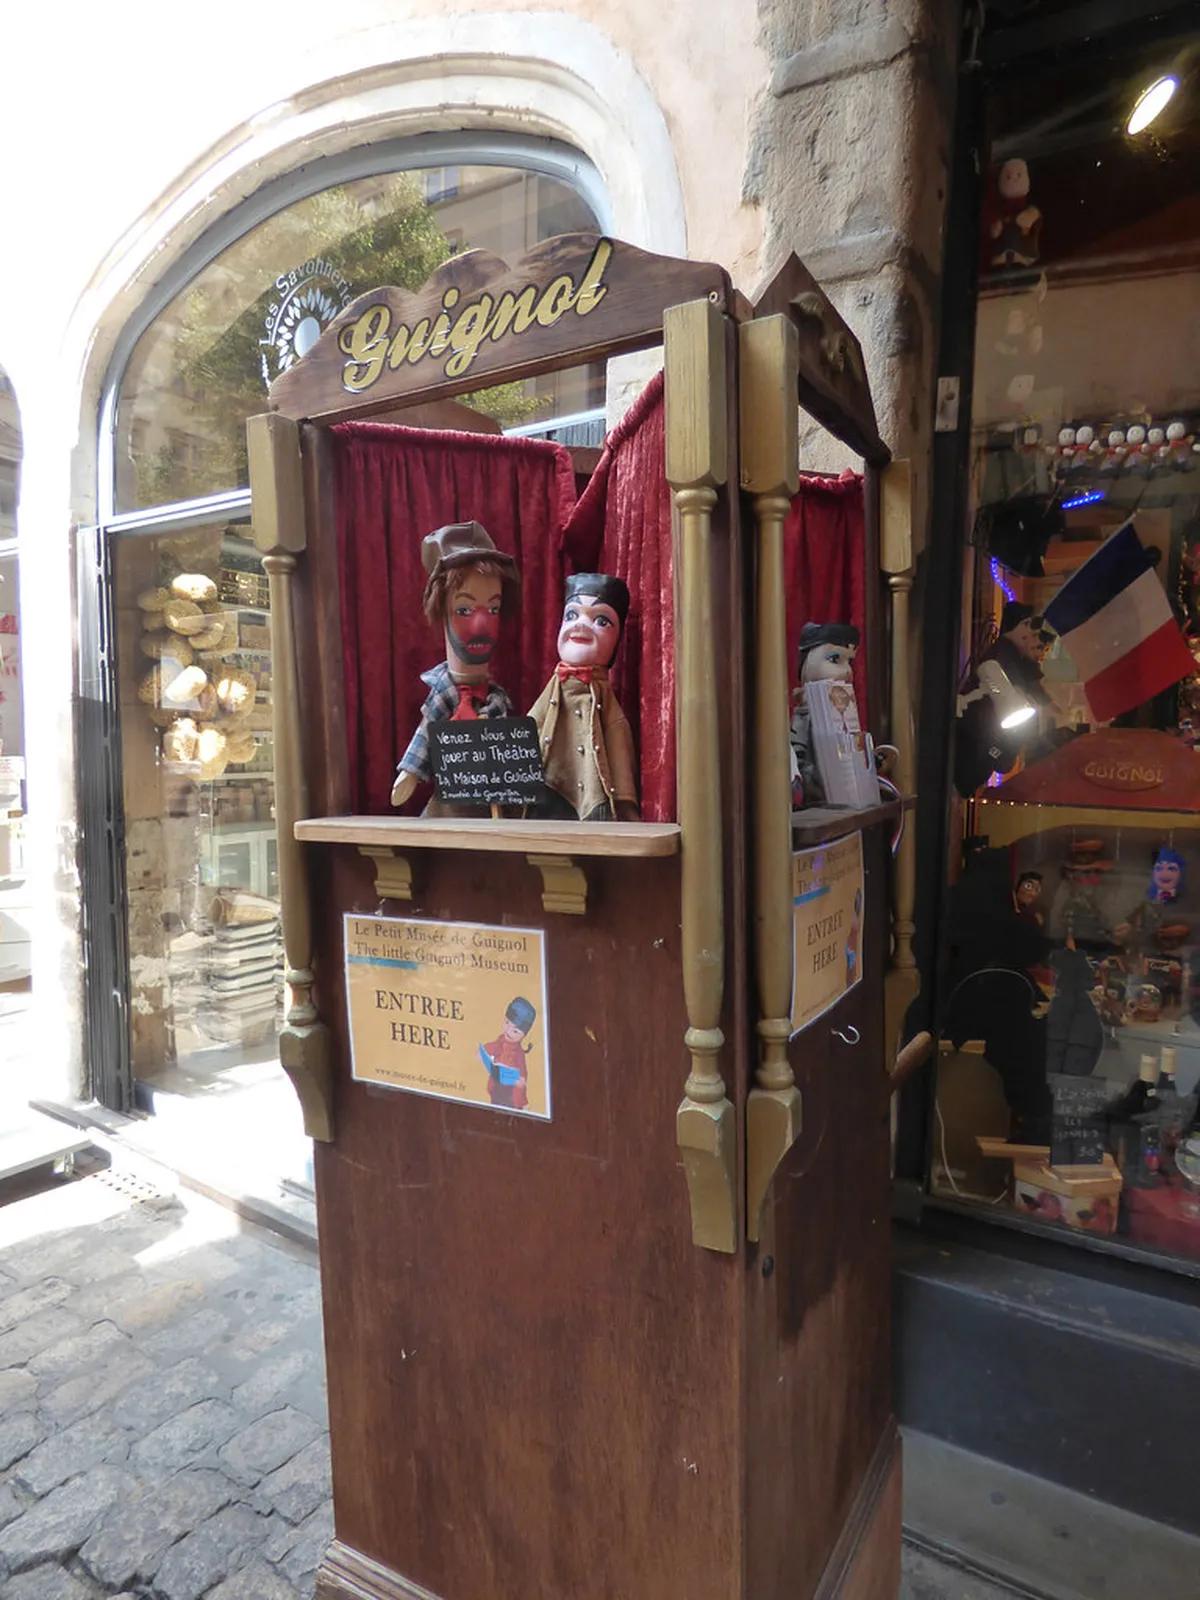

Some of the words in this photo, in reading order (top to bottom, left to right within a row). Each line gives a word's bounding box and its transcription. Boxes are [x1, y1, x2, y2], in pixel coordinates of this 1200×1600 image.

[338, 237, 612, 394] Guignol
[437, 732, 472, 745] Venez
[440, 749, 469, 772] jouer
[472, 751, 486, 762] au
[453, 771, 488, 785] Maison
[490, 772, 500, 783] de
[355, 922, 370, 937] Le
[374, 923, 402, 940] Petit
[472, 932, 527, 953] Guignol
[807, 909, 845, 947] ENTREE
[355, 941, 379, 957] The
[382, 944, 411, 961] little
[471, 953, 529, 975] Museum
[812, 941, 838, 974] HERE
[375, 989, 464, 1021] ENTREE
[391, 1021, 451, 1051] HERE
